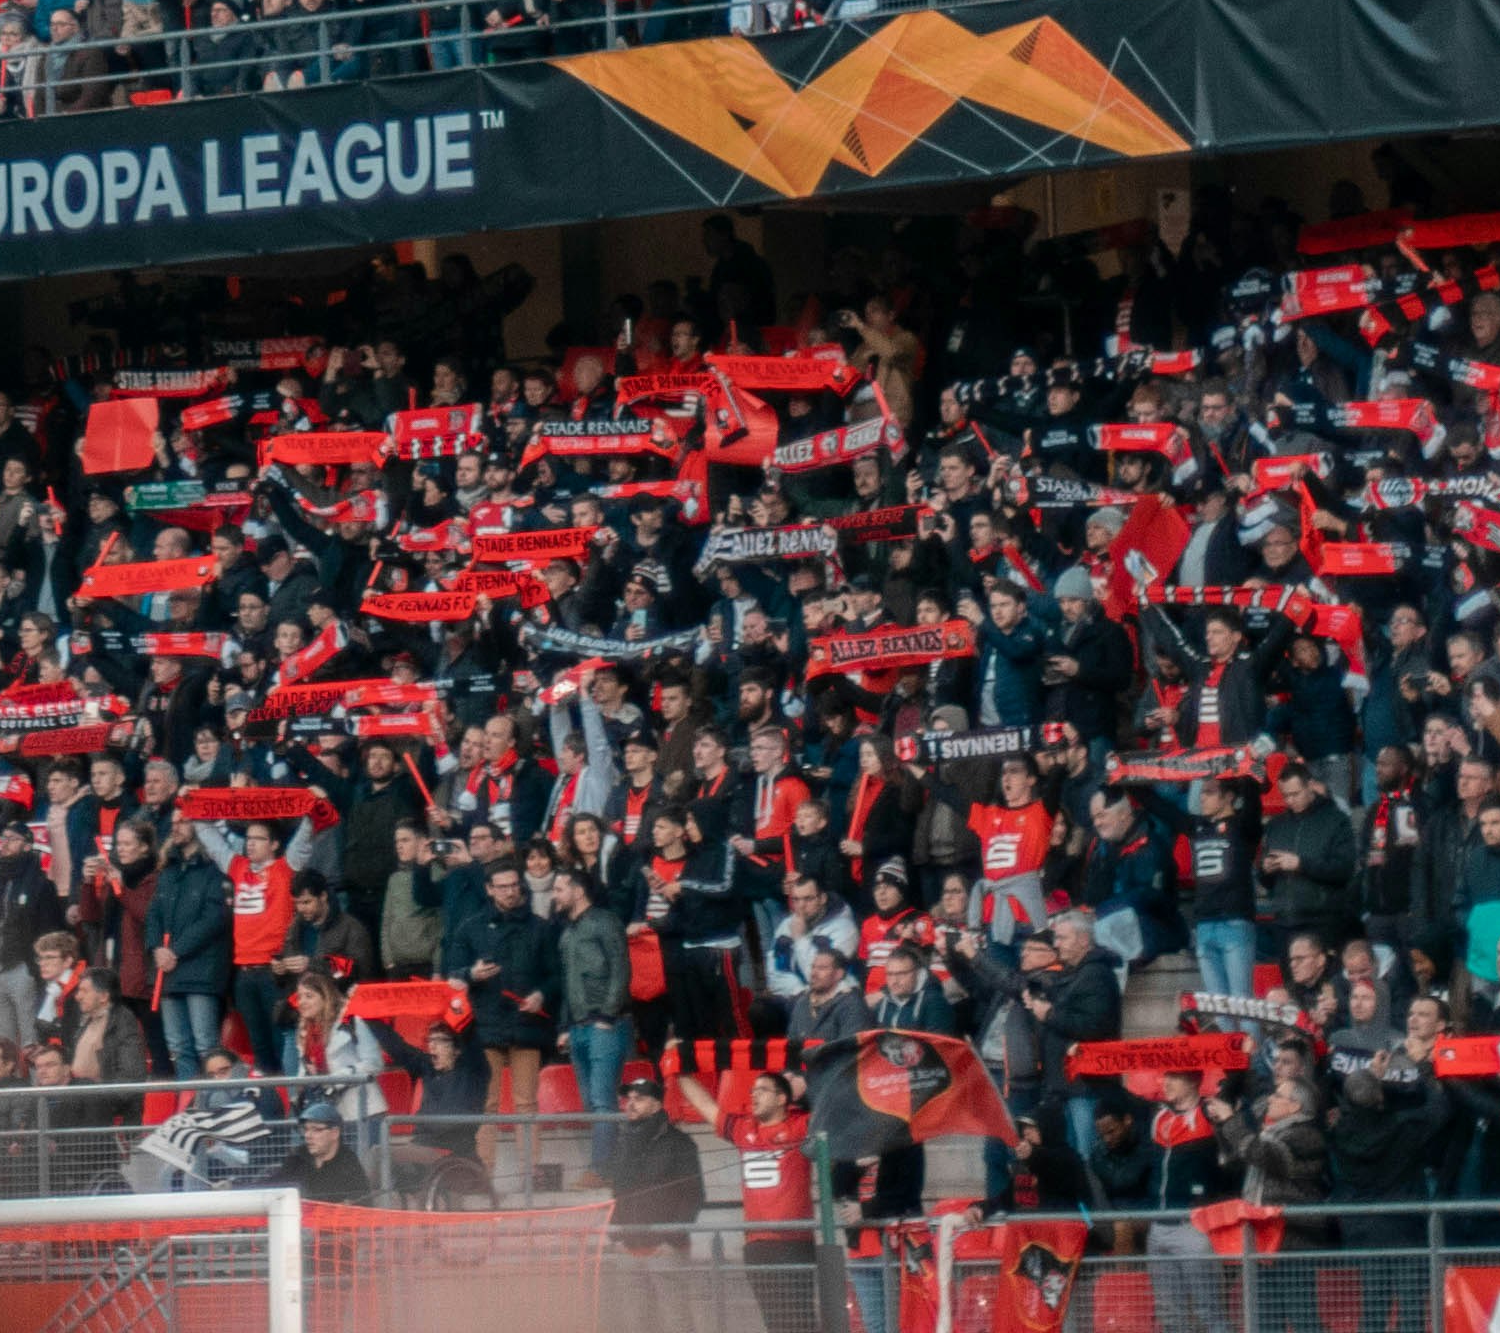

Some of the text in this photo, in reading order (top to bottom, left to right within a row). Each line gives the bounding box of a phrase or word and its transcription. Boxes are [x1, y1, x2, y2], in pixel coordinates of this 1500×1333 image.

[203, 112, 475, 214] LEAGUE
[212, 339, 254, 357] STADE
[621, 377, 658, 397] STADE
[543, 416, 652, 437] STADE RENNAIS
[774, 442, 815, 467] ALLEZ
[475, 532, 571, 554] STADE RENNAIS
[731, 530, 775, 556] ALLEZ
[395, 595, 449, 613] RENNAIS
[829, 632, 944, 664] ALLEZ RENNES
[1193, 989, 1301, 1028] RENNES
[1095, 1053, 1131, 1073] STADE
